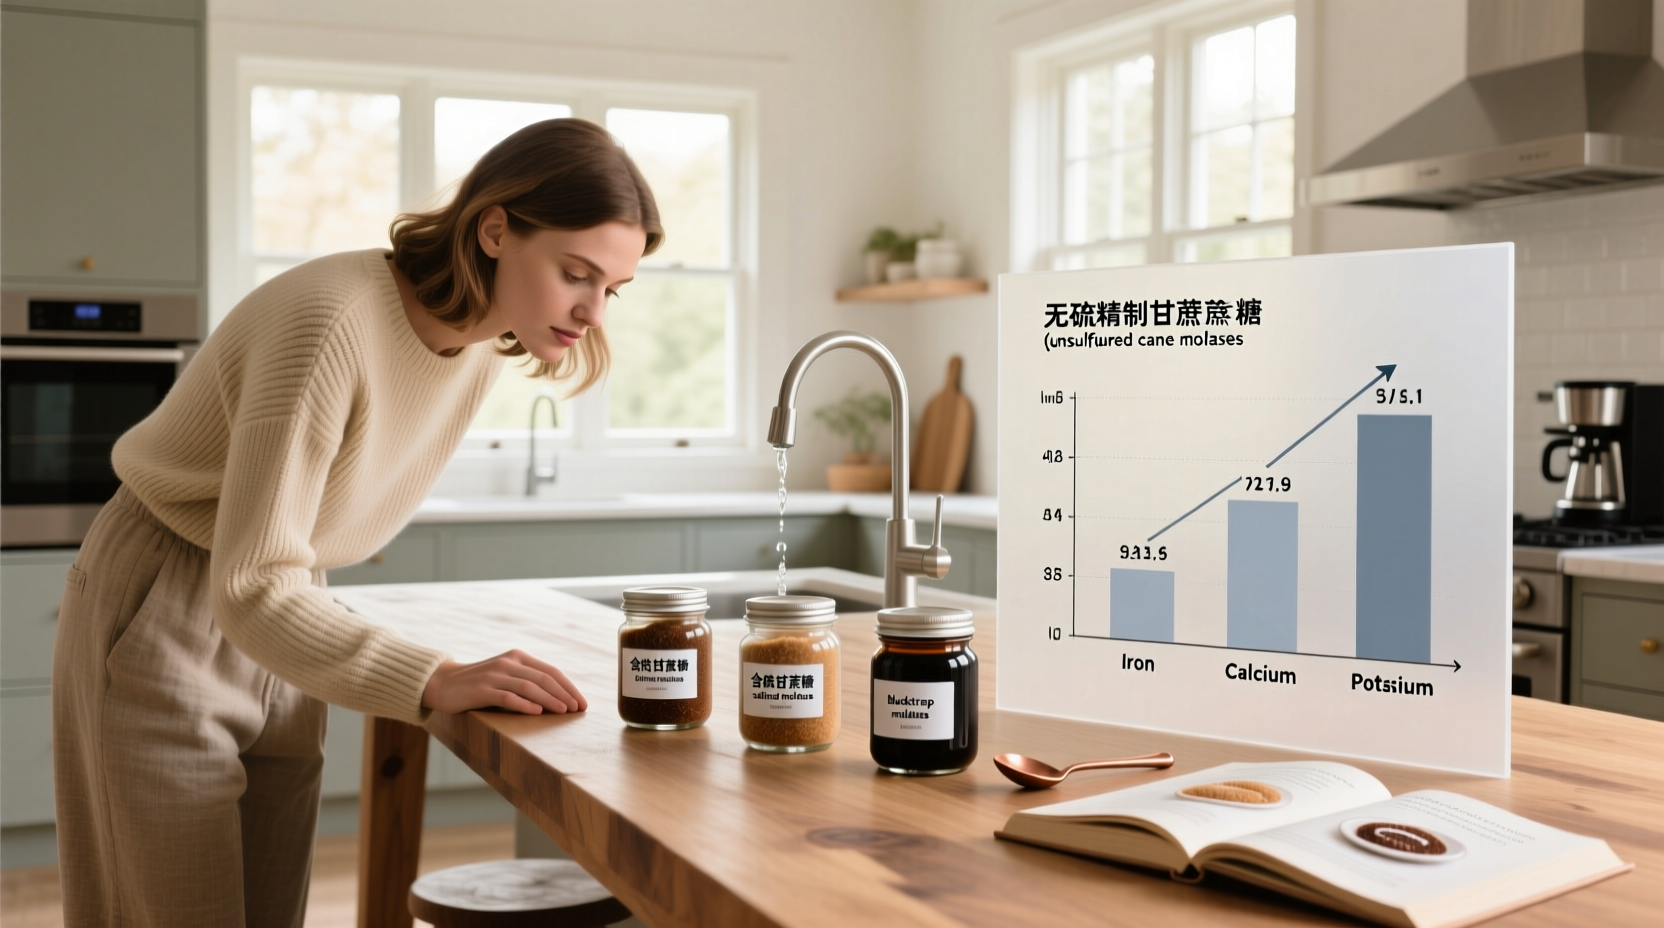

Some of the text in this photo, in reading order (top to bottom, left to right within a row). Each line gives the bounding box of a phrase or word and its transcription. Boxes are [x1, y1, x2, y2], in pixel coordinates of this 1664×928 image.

[1138, 335, 1174, 346] cane
[1180, 331, 1243, 346] molases
[1122, 653, 1154, 672] Iron
[1225, 662, 1296, 684] Calcium
